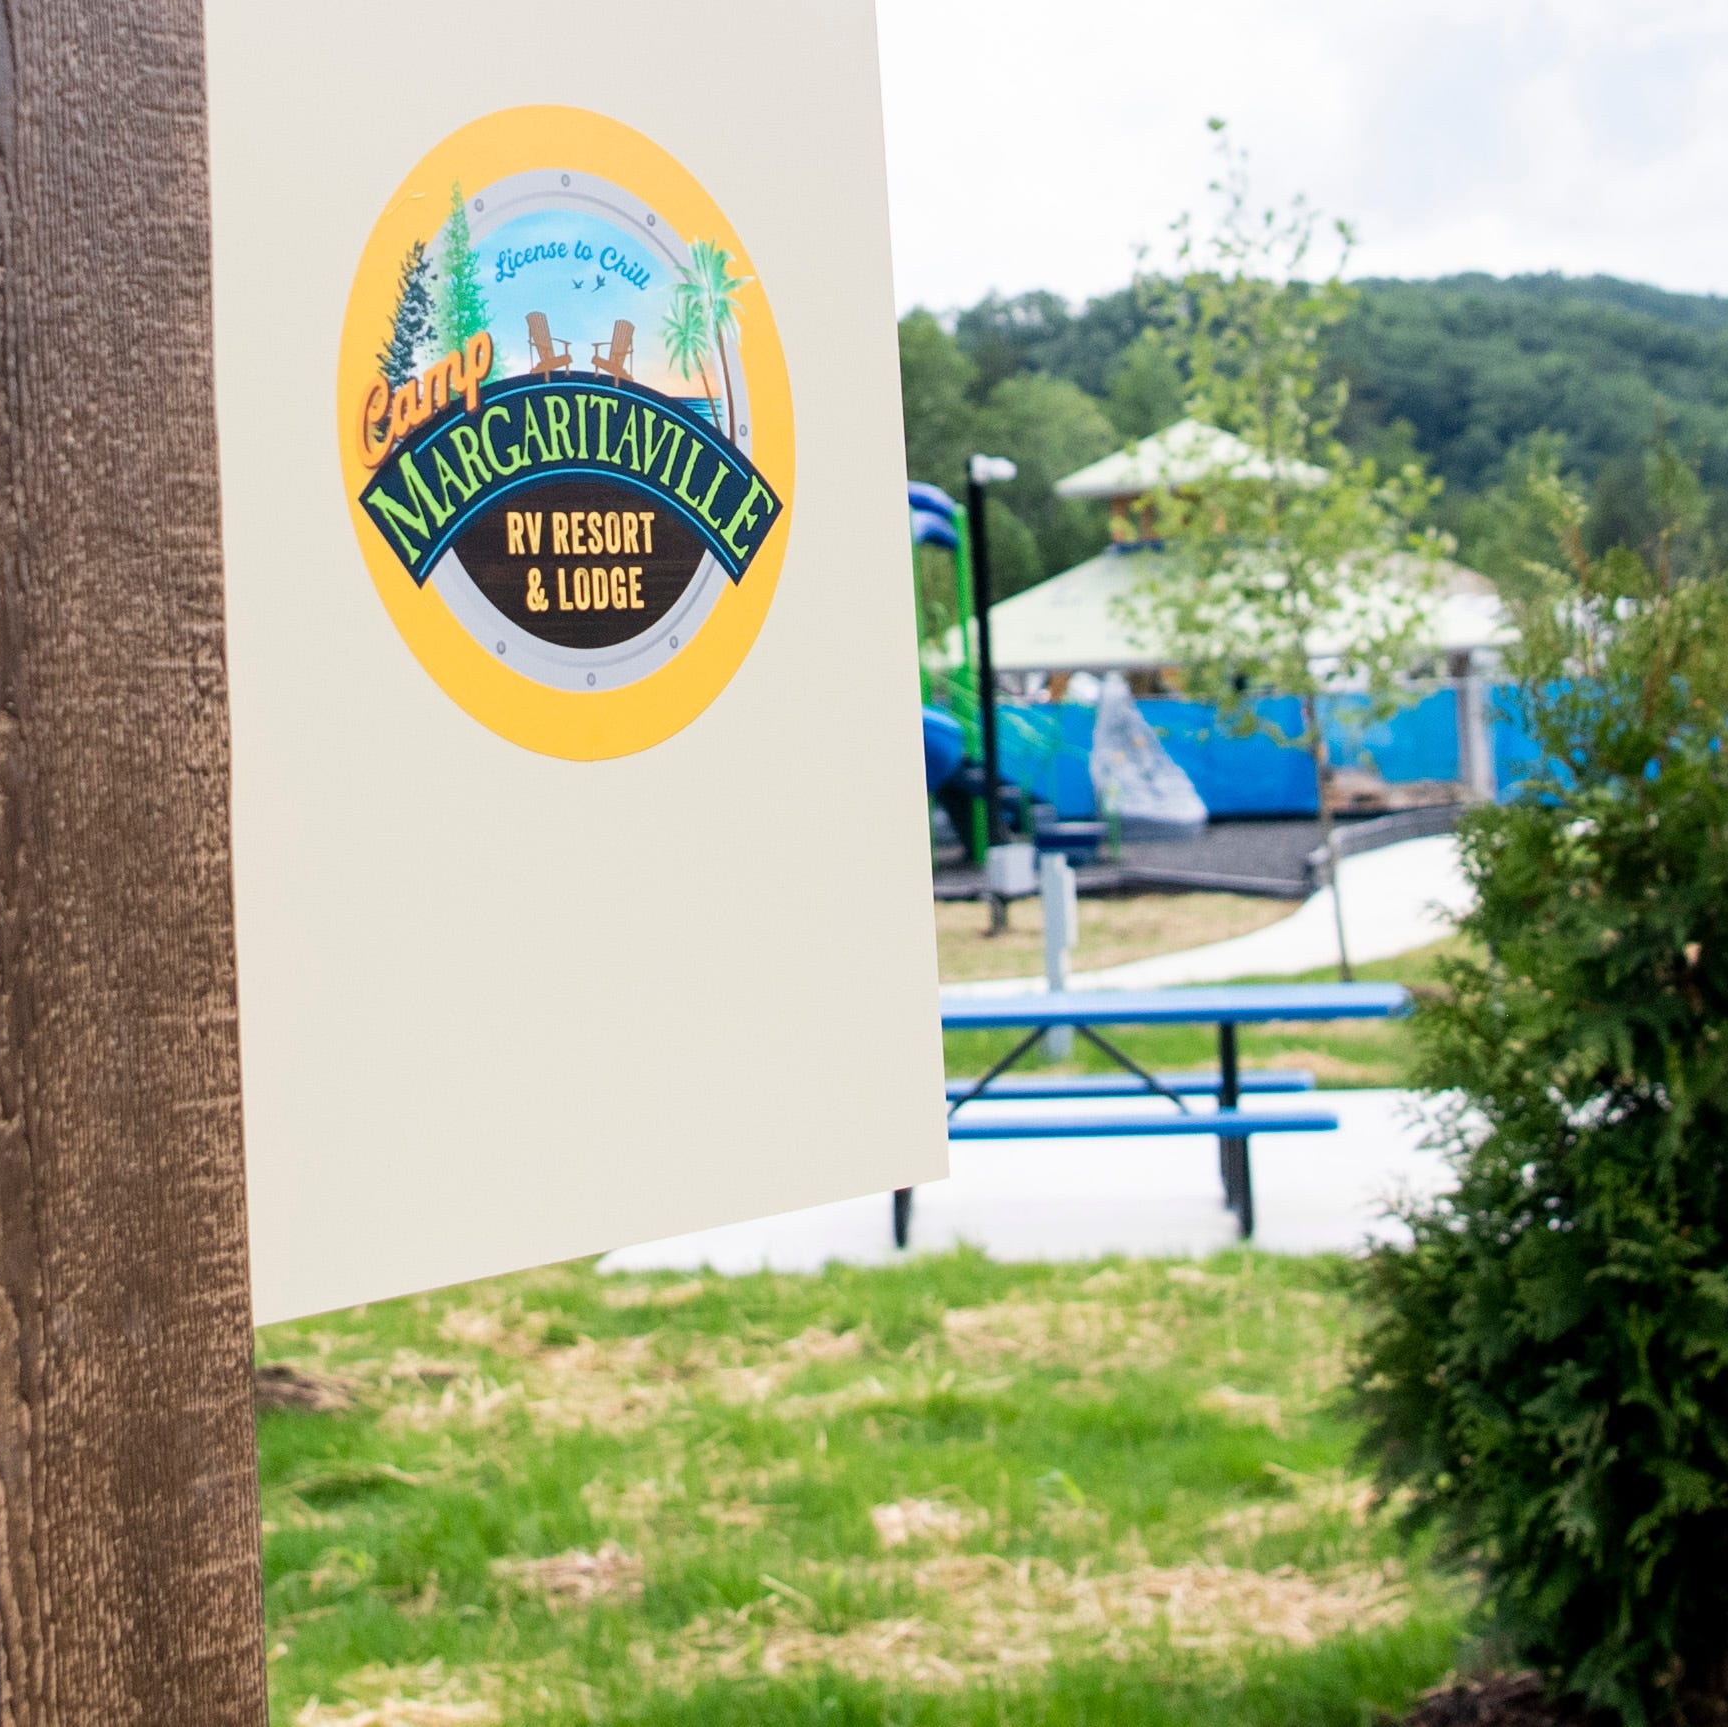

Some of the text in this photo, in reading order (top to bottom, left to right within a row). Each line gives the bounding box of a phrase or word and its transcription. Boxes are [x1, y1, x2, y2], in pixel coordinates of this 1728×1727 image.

[495, 240, 651, 291] License to Chill
[361, 332, 493, 467] Camp
[369, 394, 774, 564] MARGARITAVILLE
[506, 511, 656, 556] RV RESORT
[526, 566, 646, 612] & LODGE
